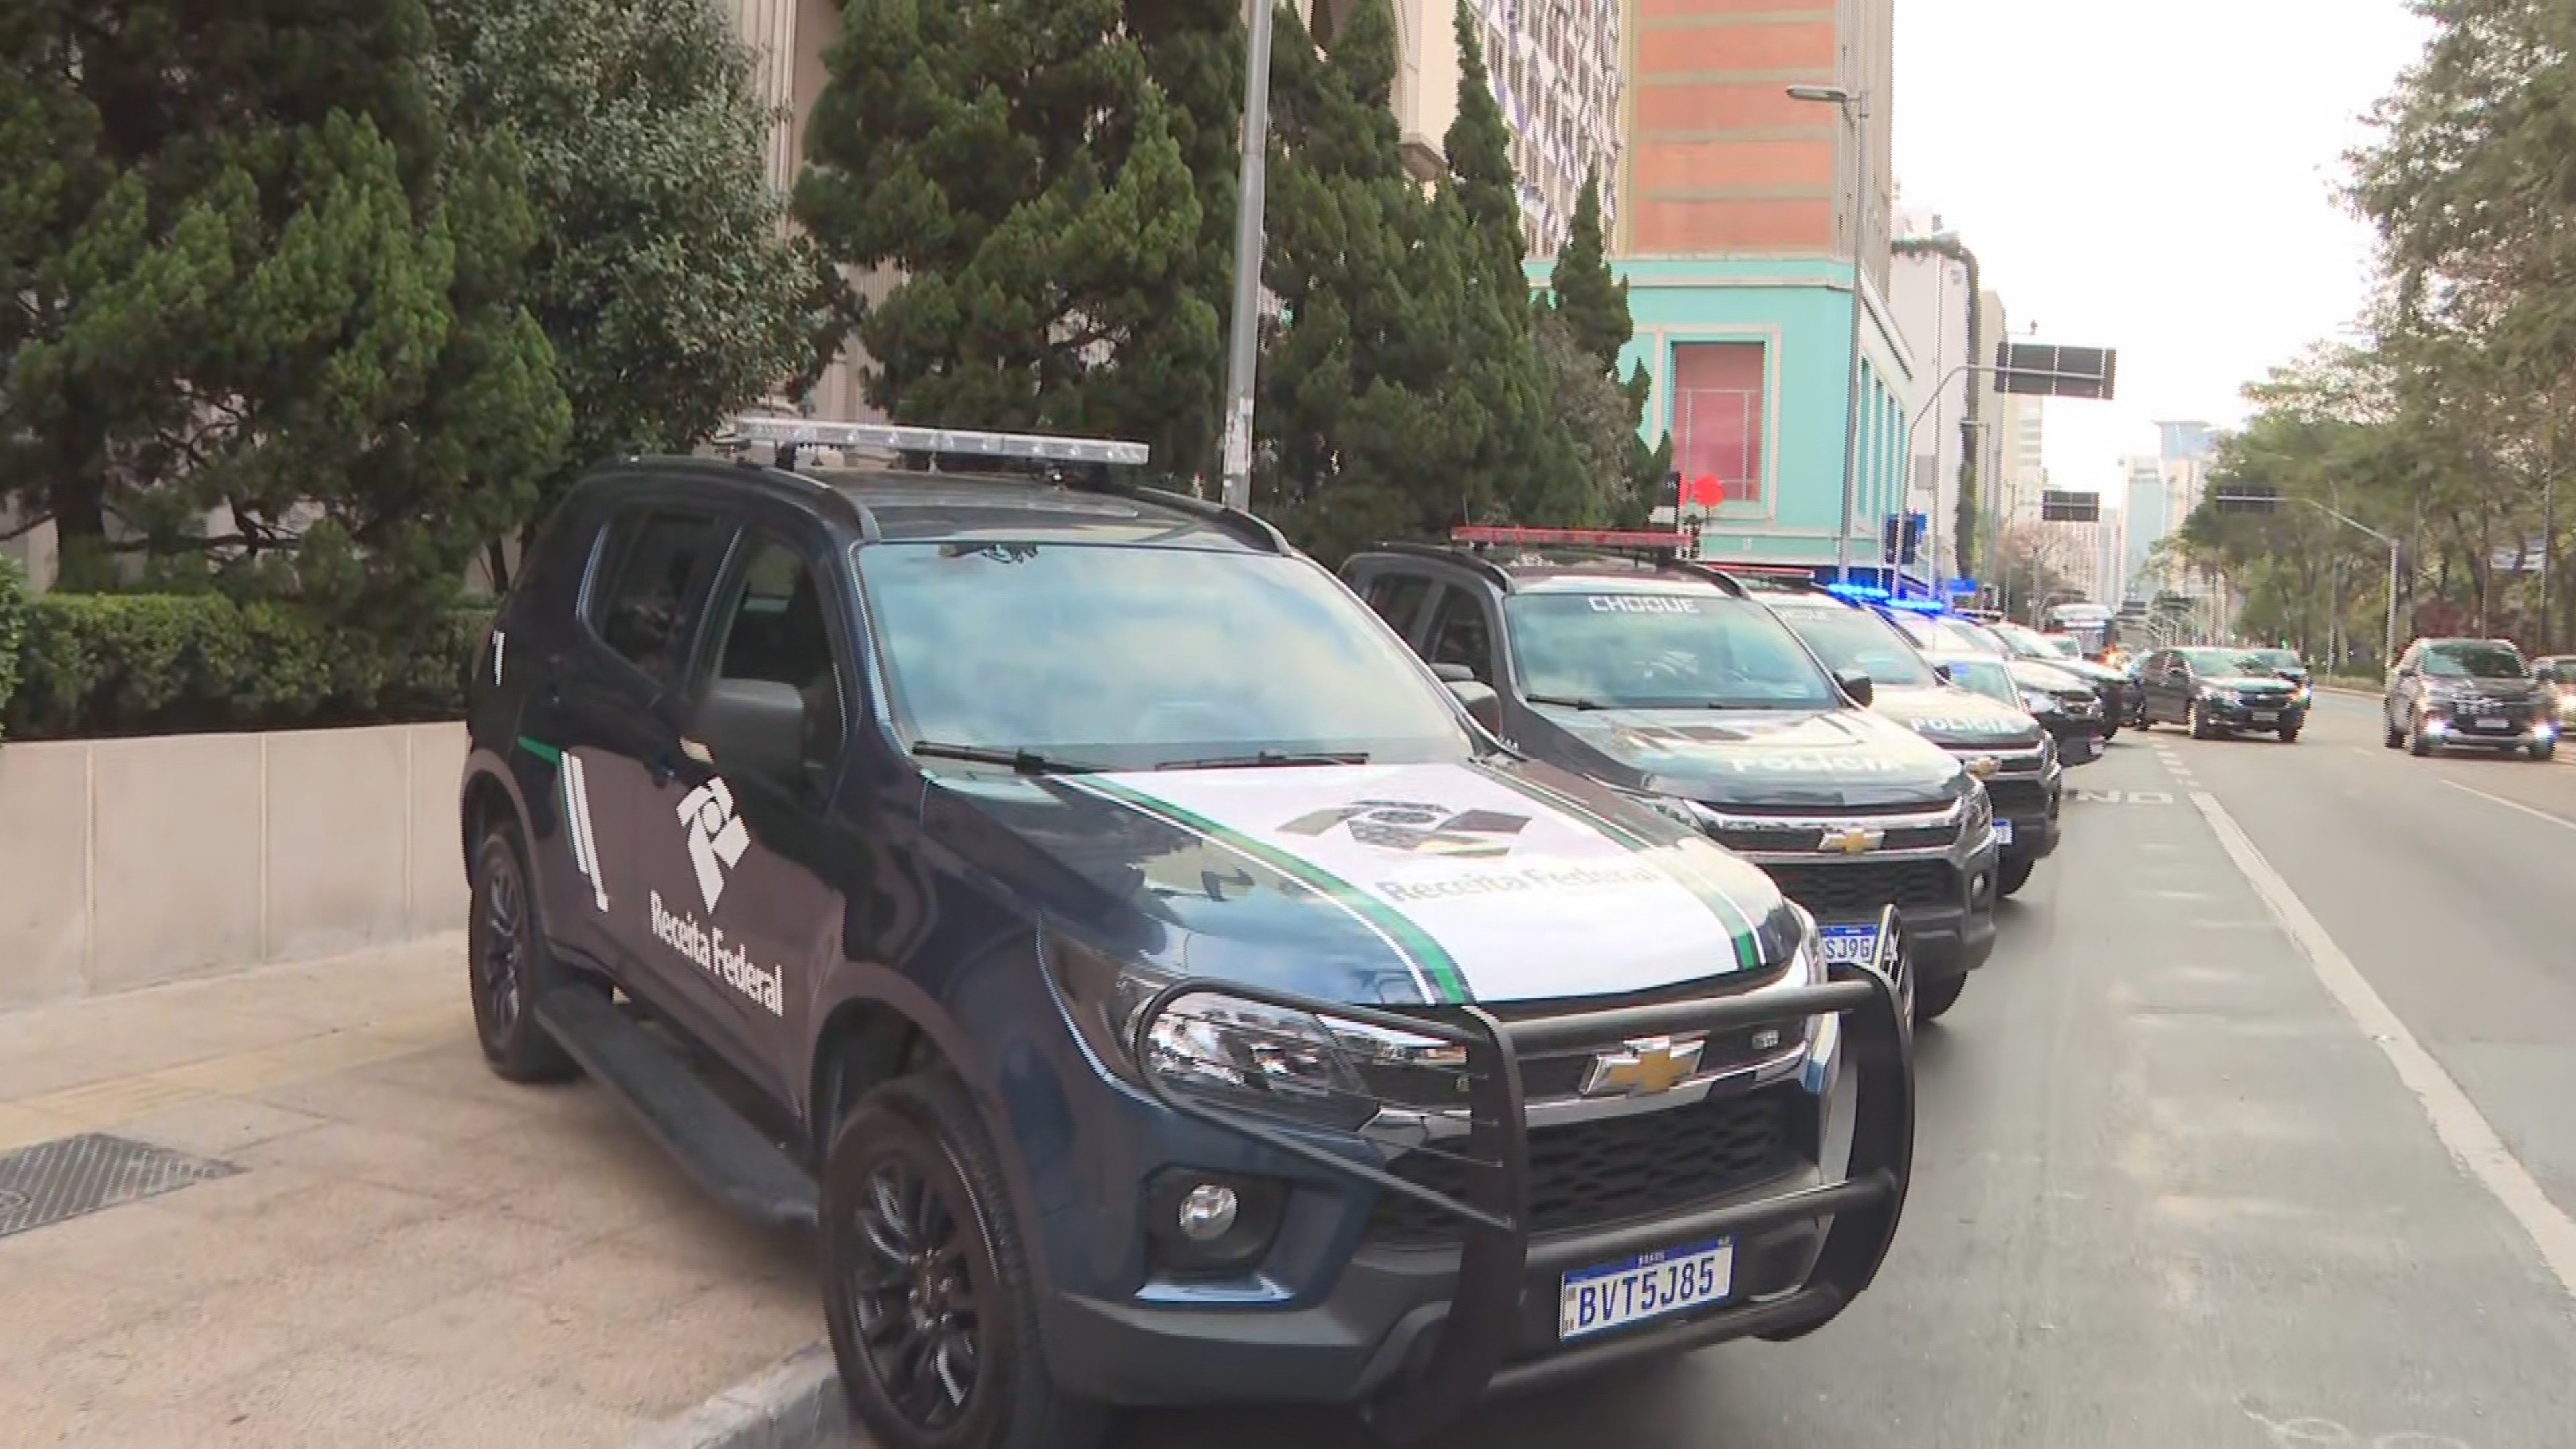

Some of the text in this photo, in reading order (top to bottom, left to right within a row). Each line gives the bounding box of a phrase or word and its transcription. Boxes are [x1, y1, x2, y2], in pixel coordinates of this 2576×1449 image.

[1588, 595, 1701, 614] CHOQUE
[1373, 873, 1531, 902] Receita
[650, 890, 784, 1017] Receita Federal
[1825, 938, 1872, 959] SJ9G
[1578, 1255, 1715, 1327] BVT5J85
